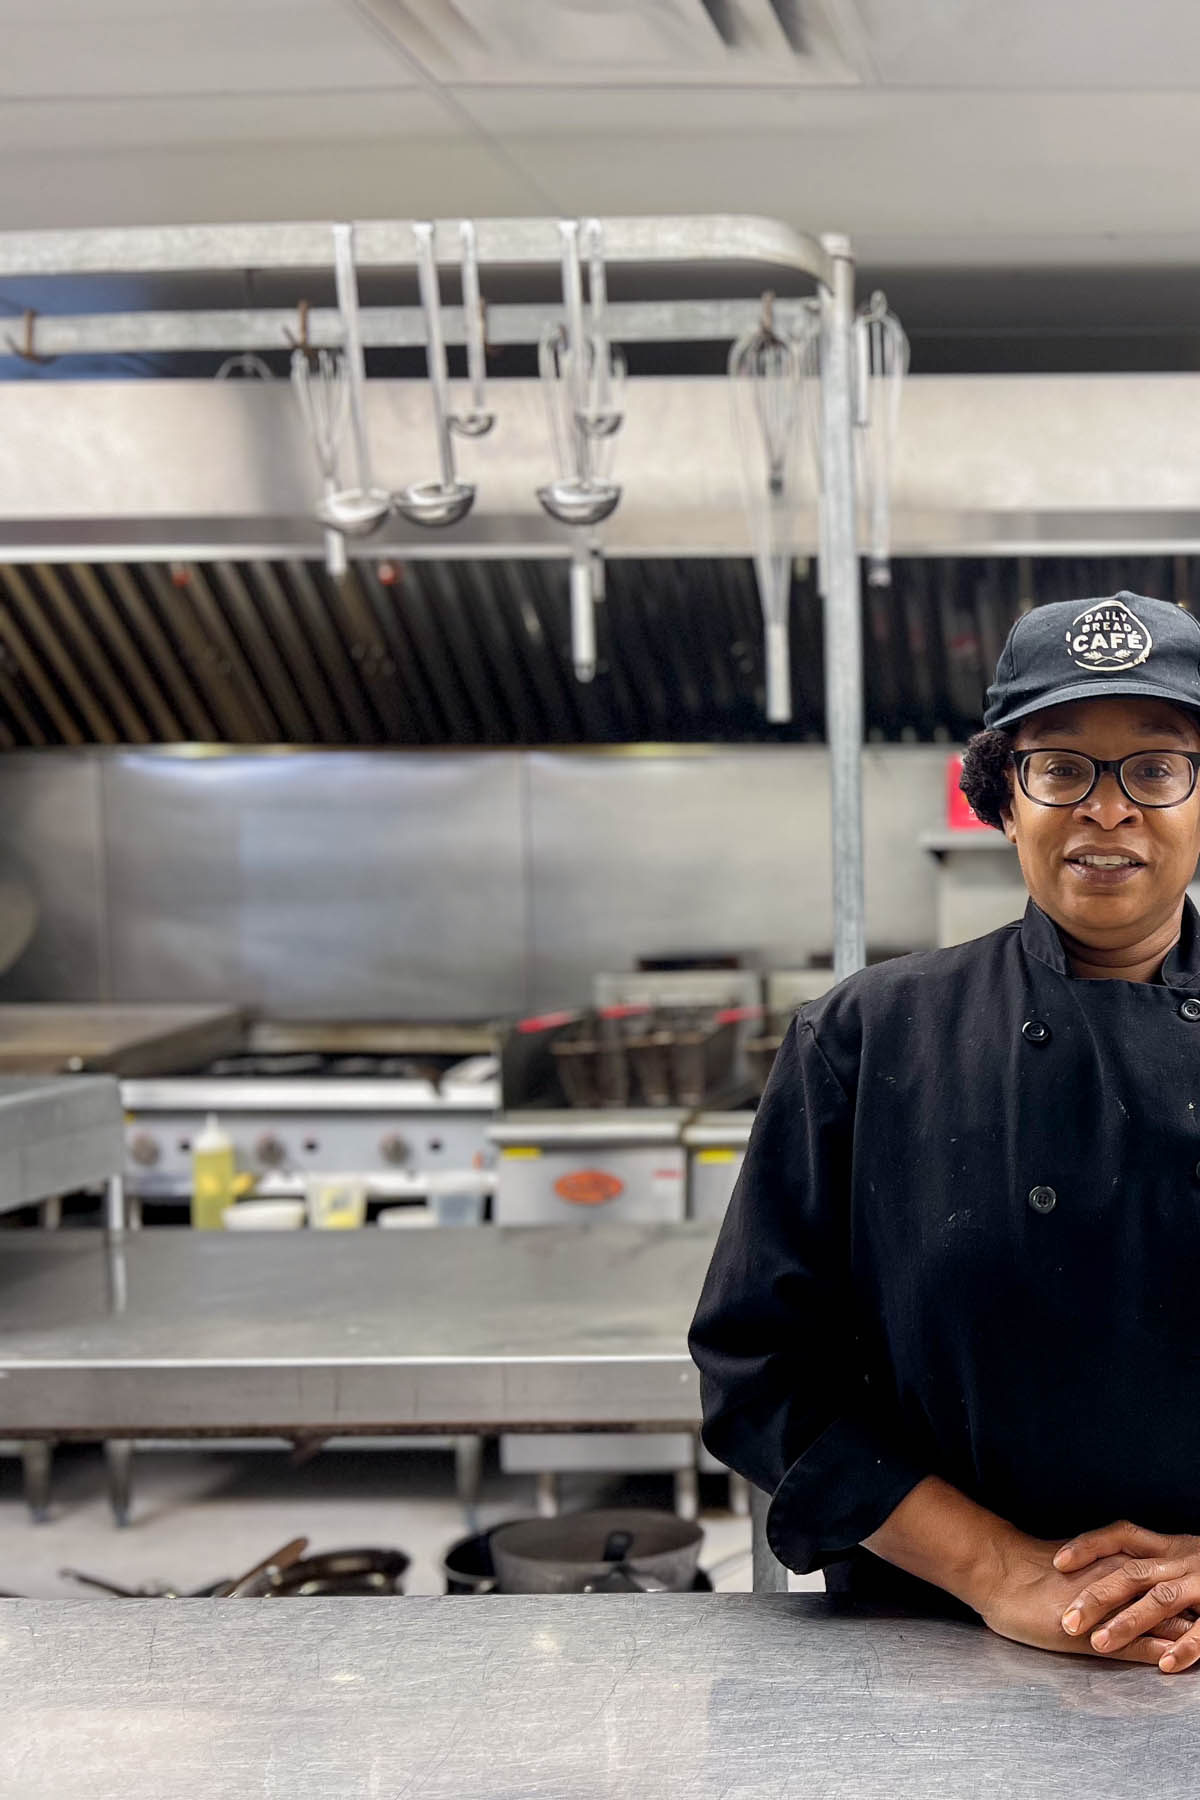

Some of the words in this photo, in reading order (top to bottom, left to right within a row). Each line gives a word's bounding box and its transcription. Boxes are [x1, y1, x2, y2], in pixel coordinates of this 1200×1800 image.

[1085, 611, 1127, 623] DAILY
[1082, 622, 1132, 633] BREAD
[1073, 631, 1143, 652] CAFÉ
